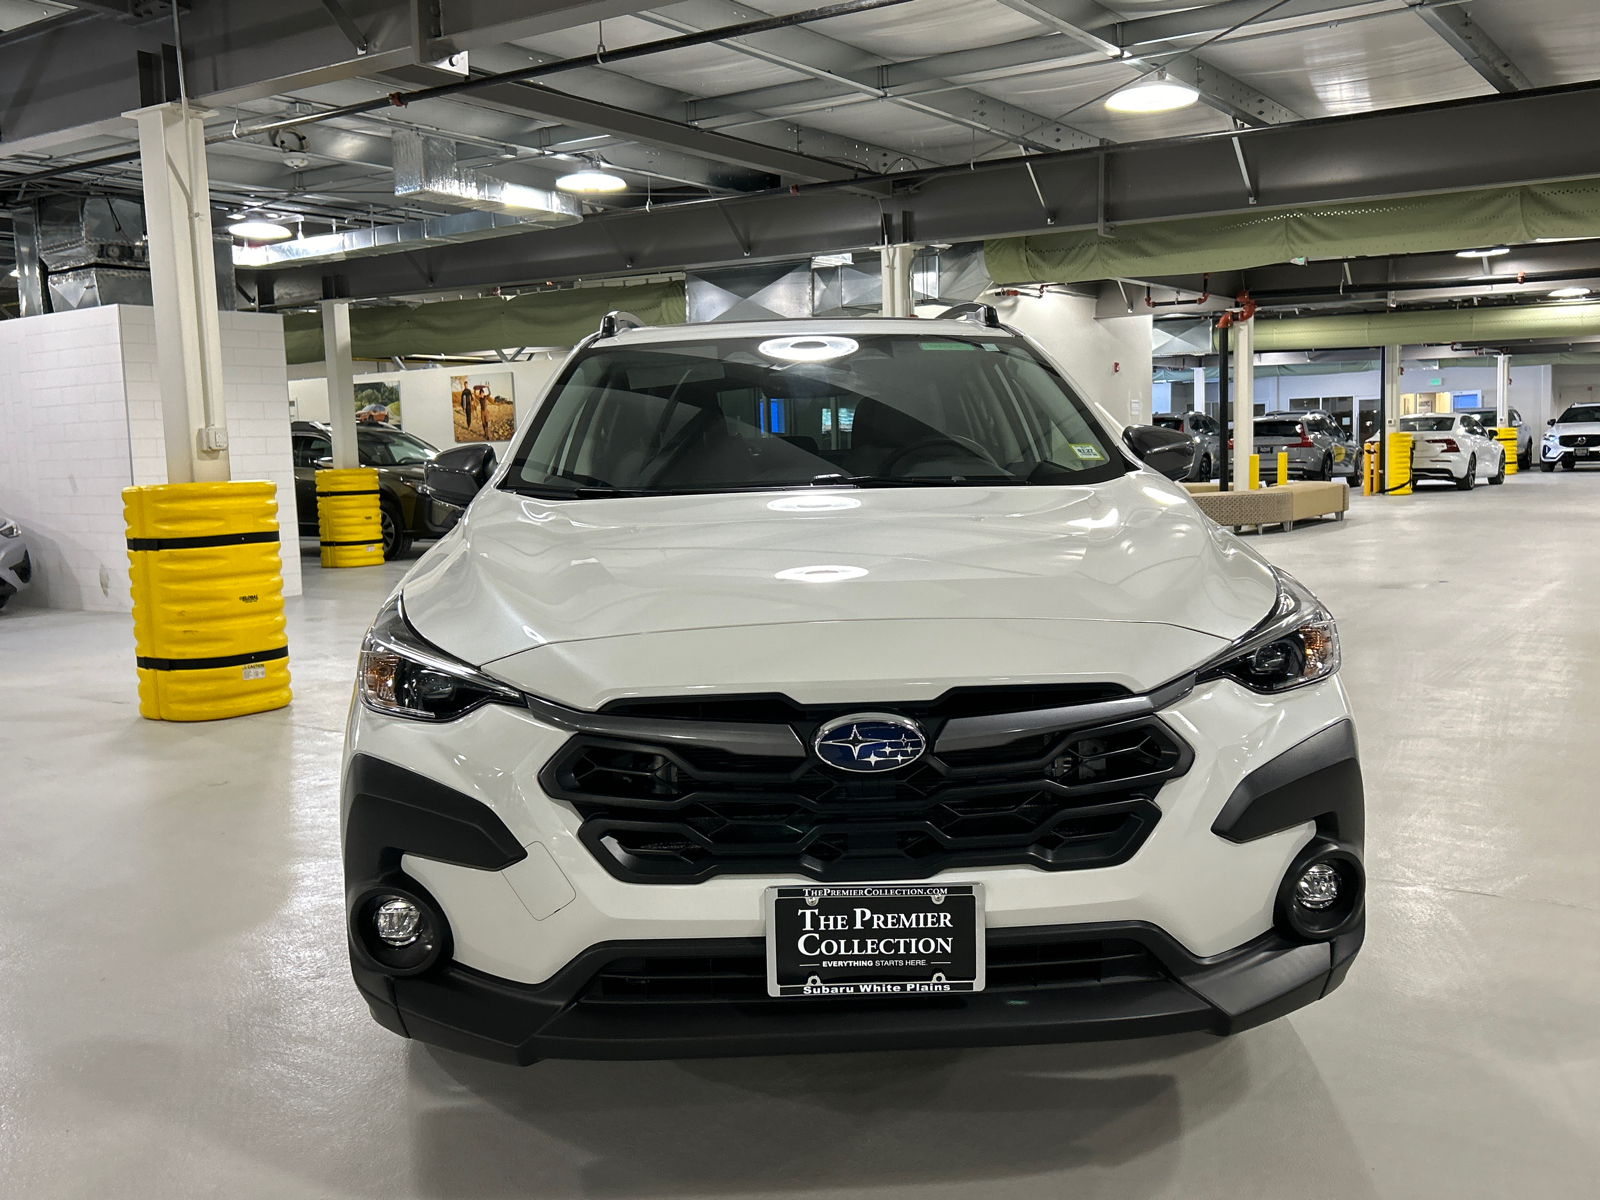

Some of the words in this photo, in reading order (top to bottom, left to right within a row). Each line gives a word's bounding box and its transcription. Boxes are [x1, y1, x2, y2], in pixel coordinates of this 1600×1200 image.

[797, 908, 848, 931] THE
[853, 907, 953, 930] PREMIER
[797, 933, 953, 956] COLLECTION
[822, 960, 873, 968] EVERYTHING
[874, 959, 904, 967] STARTS
[803, 985, 854, 995] Subaru
[859, 983, 901, 993] White
[906, 983, 951, 993] Plains
